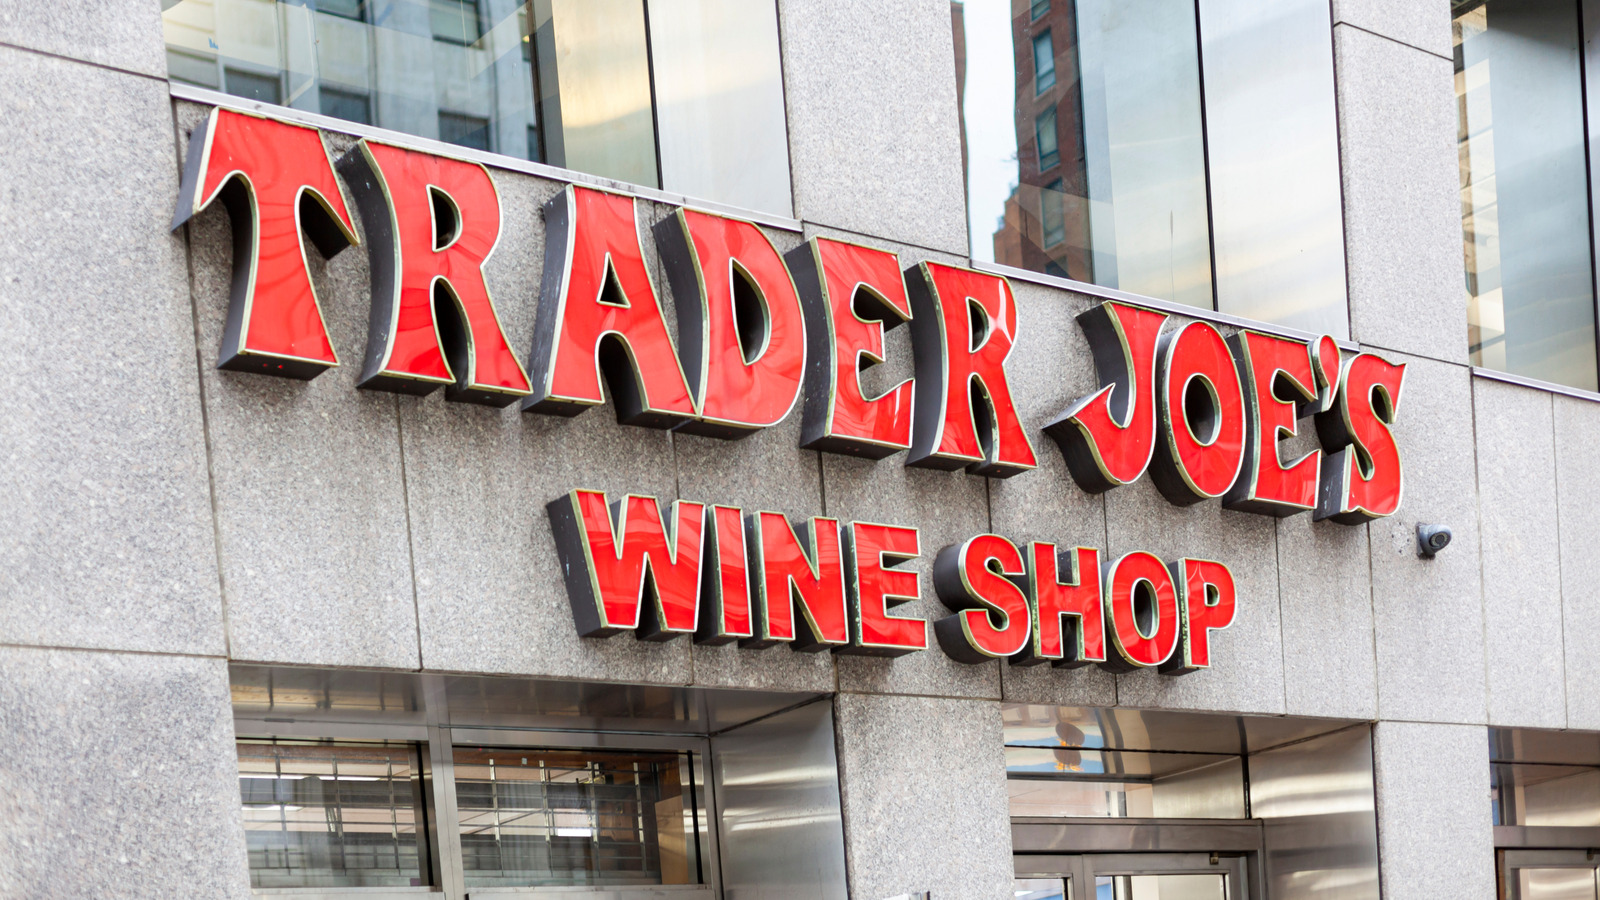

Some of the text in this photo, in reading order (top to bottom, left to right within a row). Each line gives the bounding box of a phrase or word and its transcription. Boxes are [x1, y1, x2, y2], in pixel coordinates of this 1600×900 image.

[191, 106, 1406, 519] TRADER JOE'S
[567, 487, 1237, 670] WINE SHOP
